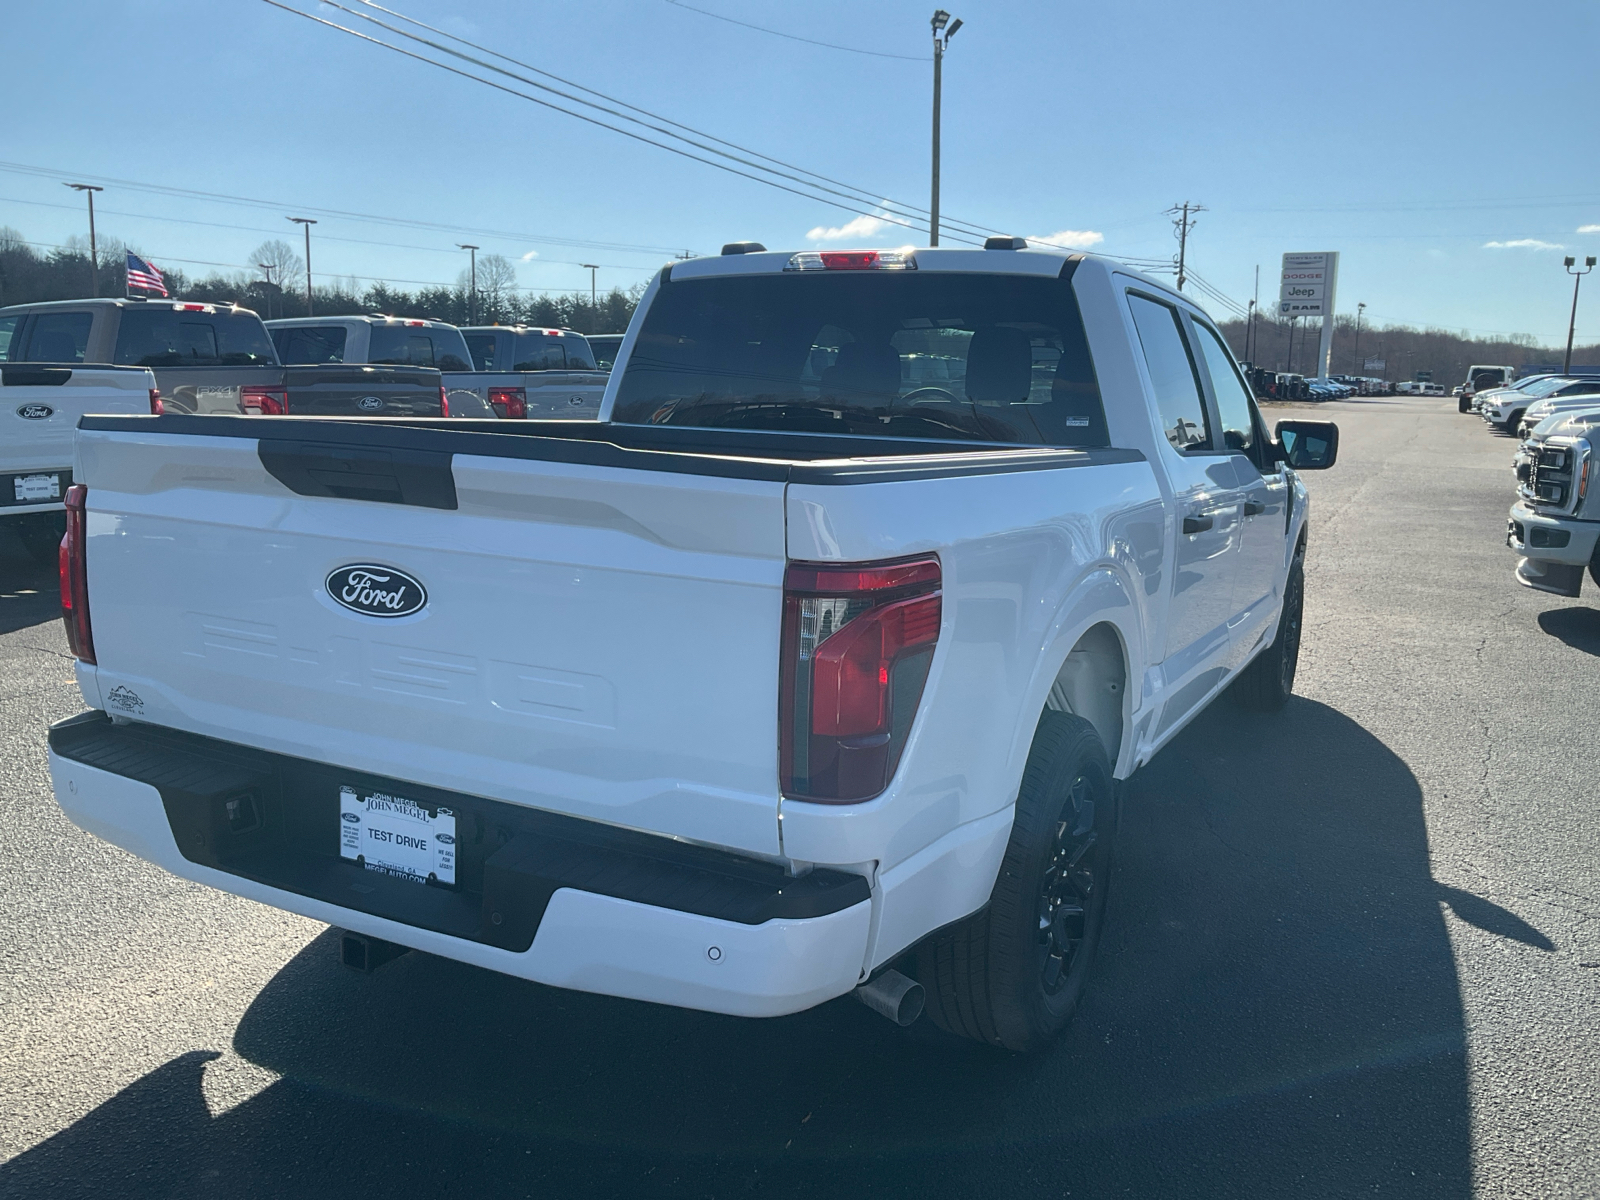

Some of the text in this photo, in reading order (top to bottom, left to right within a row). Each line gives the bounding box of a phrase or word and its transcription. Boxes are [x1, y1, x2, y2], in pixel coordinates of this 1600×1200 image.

[1288, 287, 1315, 297] Jeep
[196, 385, 233, 398] FX4
[342, 570, 406, 610] Ford
[372, 792, 419, 809] JOHN MEGEL
[366, 798, 430, 823] JOHN MEGEL
[368, 827, 427, 851] TEST DRIVE
[364, 863, 426, 884] MEGELAUTOCOM
[407, 867, 417, 875] GA
